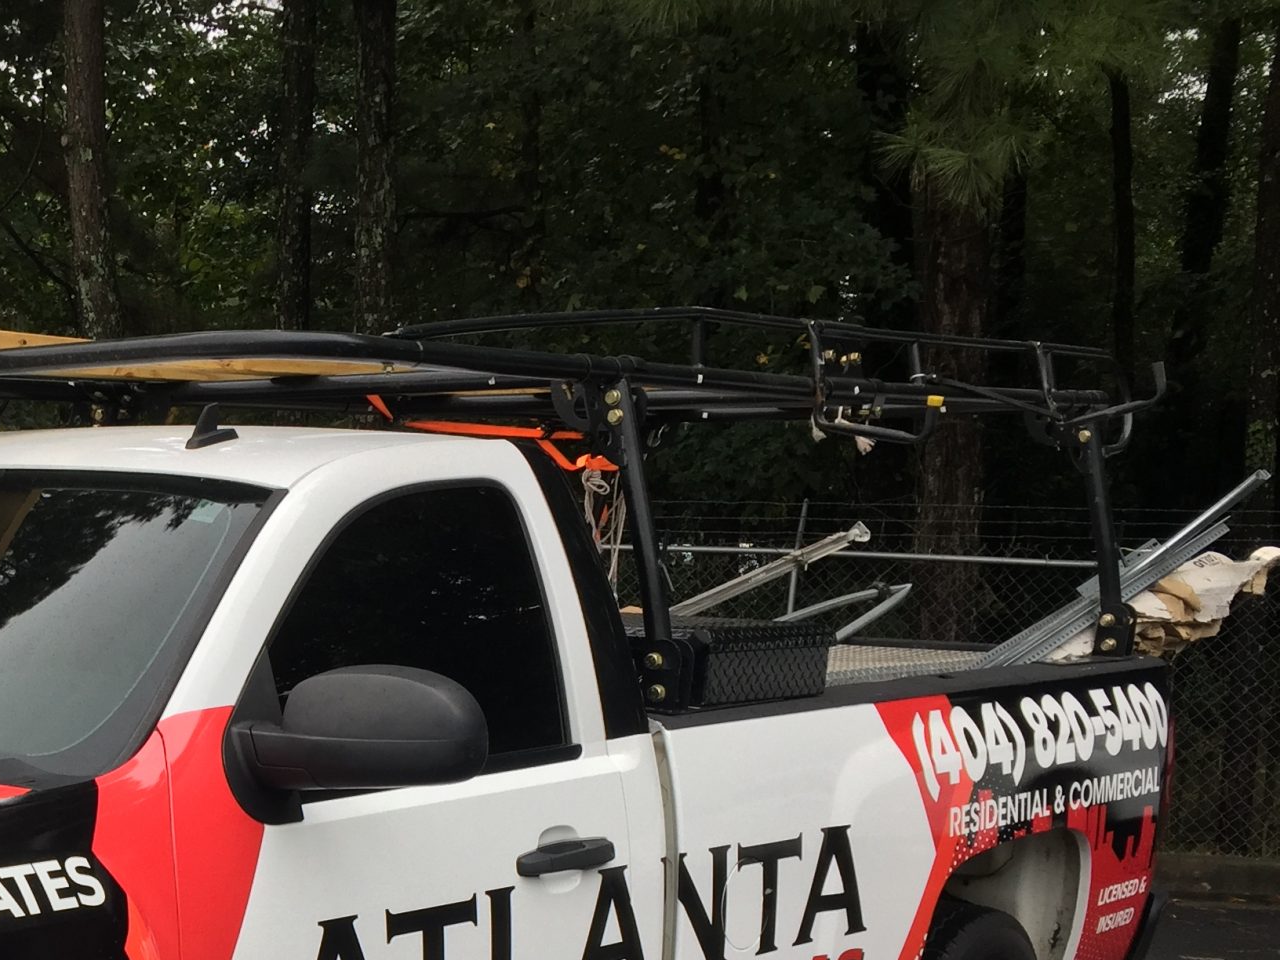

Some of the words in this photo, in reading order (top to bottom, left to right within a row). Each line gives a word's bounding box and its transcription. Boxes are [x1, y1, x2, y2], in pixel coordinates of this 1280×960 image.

[912, 701, 1026, 803] (404)
[1020, 681, 1169, 768] 820-5400
[949, 789, 1051, 838] RESIDENTIAL
[1053, 785, 1066, 815] &
[1069, 766, 1160, 811] COMMERCIAL
[1097, 878, 1140, 907] LICENSED
[1138, 875, 1148, 895] &
[1095, 907, 1135, 935] INSURED
